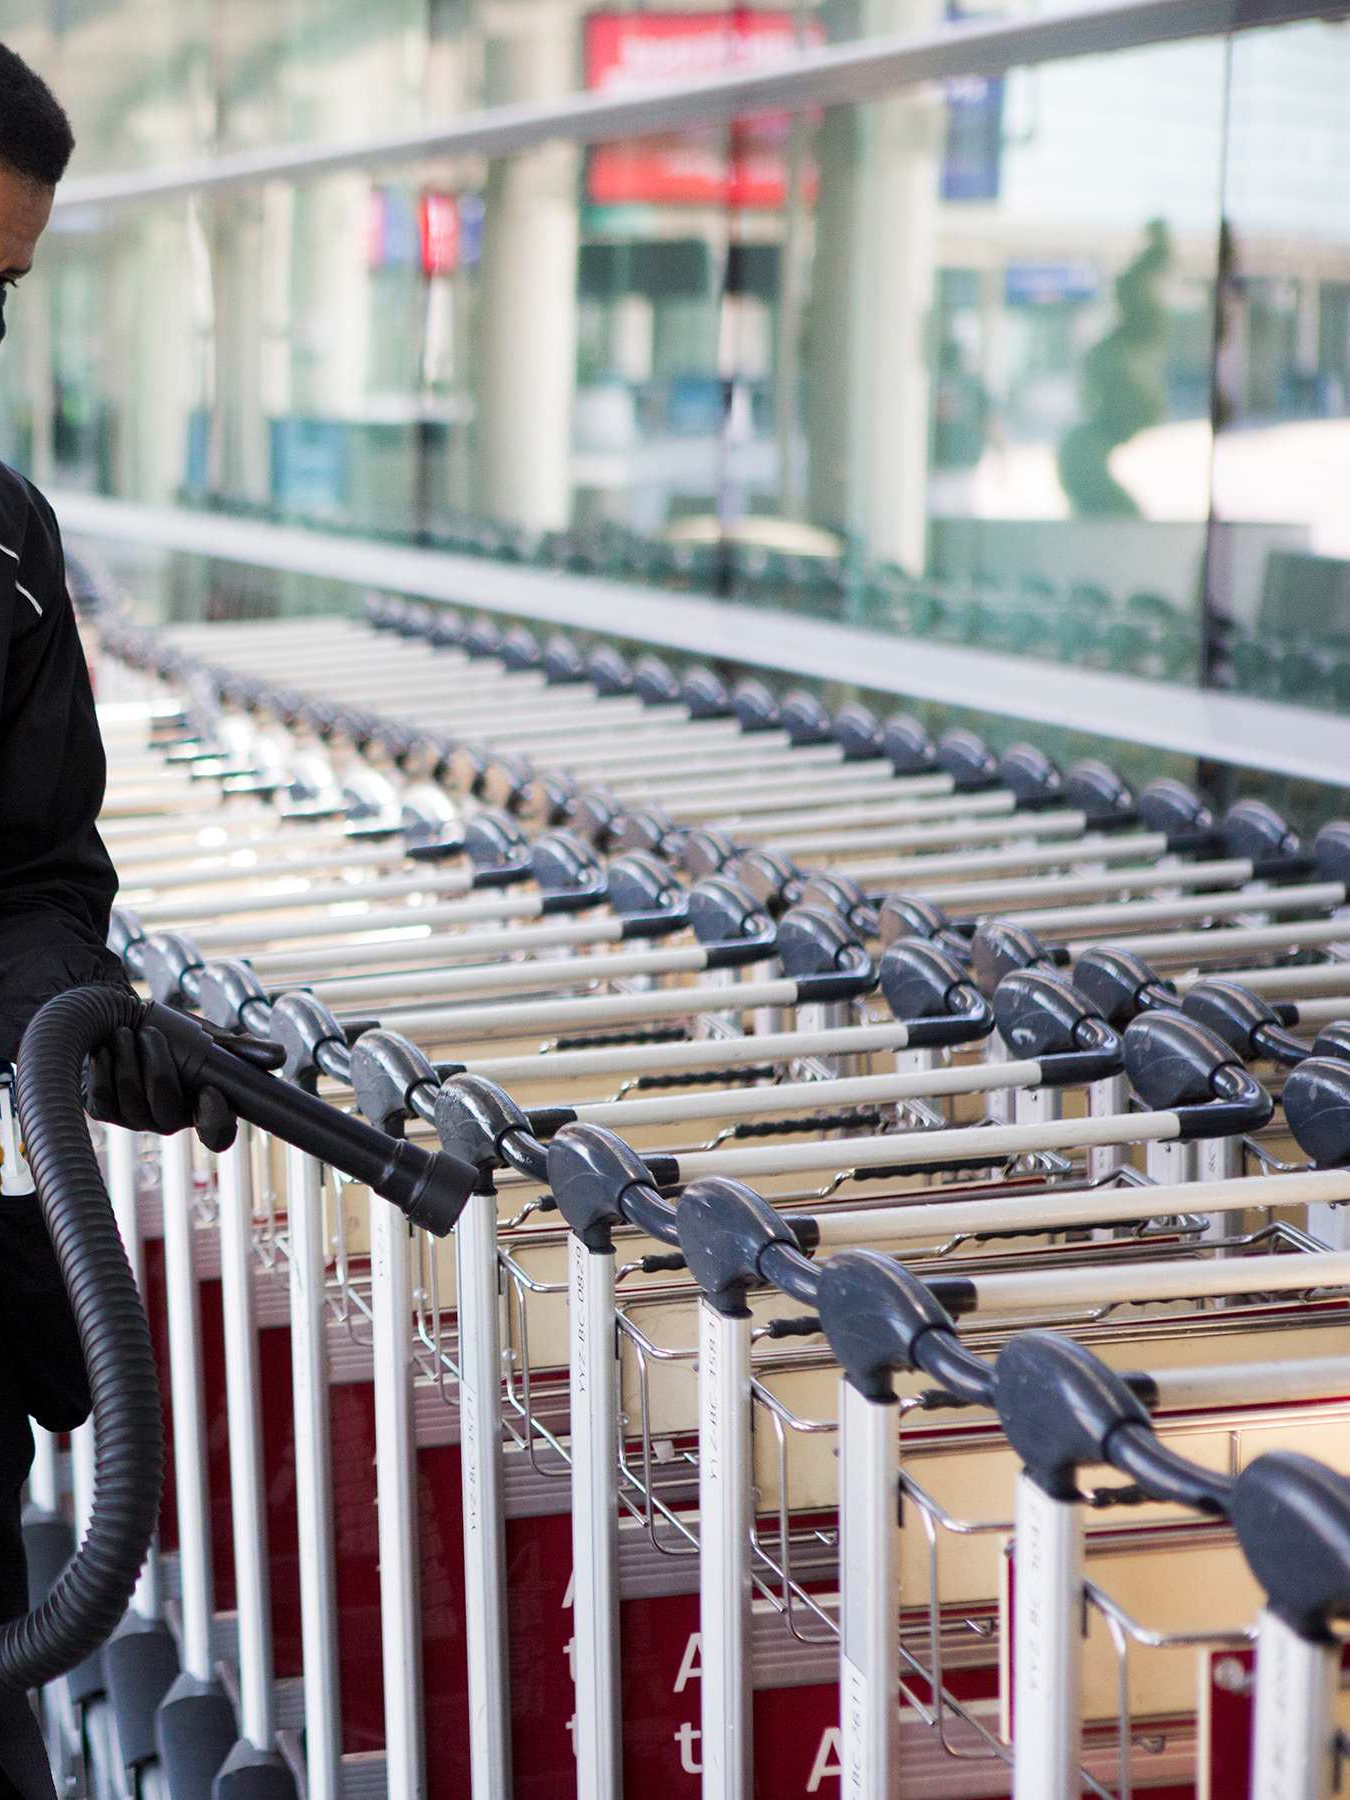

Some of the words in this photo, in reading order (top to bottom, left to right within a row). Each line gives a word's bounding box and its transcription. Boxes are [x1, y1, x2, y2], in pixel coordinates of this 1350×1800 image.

[576, 1245, 587, 1393] YYZ-BC-0829
[709, 1321, 719, 1480] YYZ-BC-3583
[851, 1677, 862, 1800] -BC-2611
